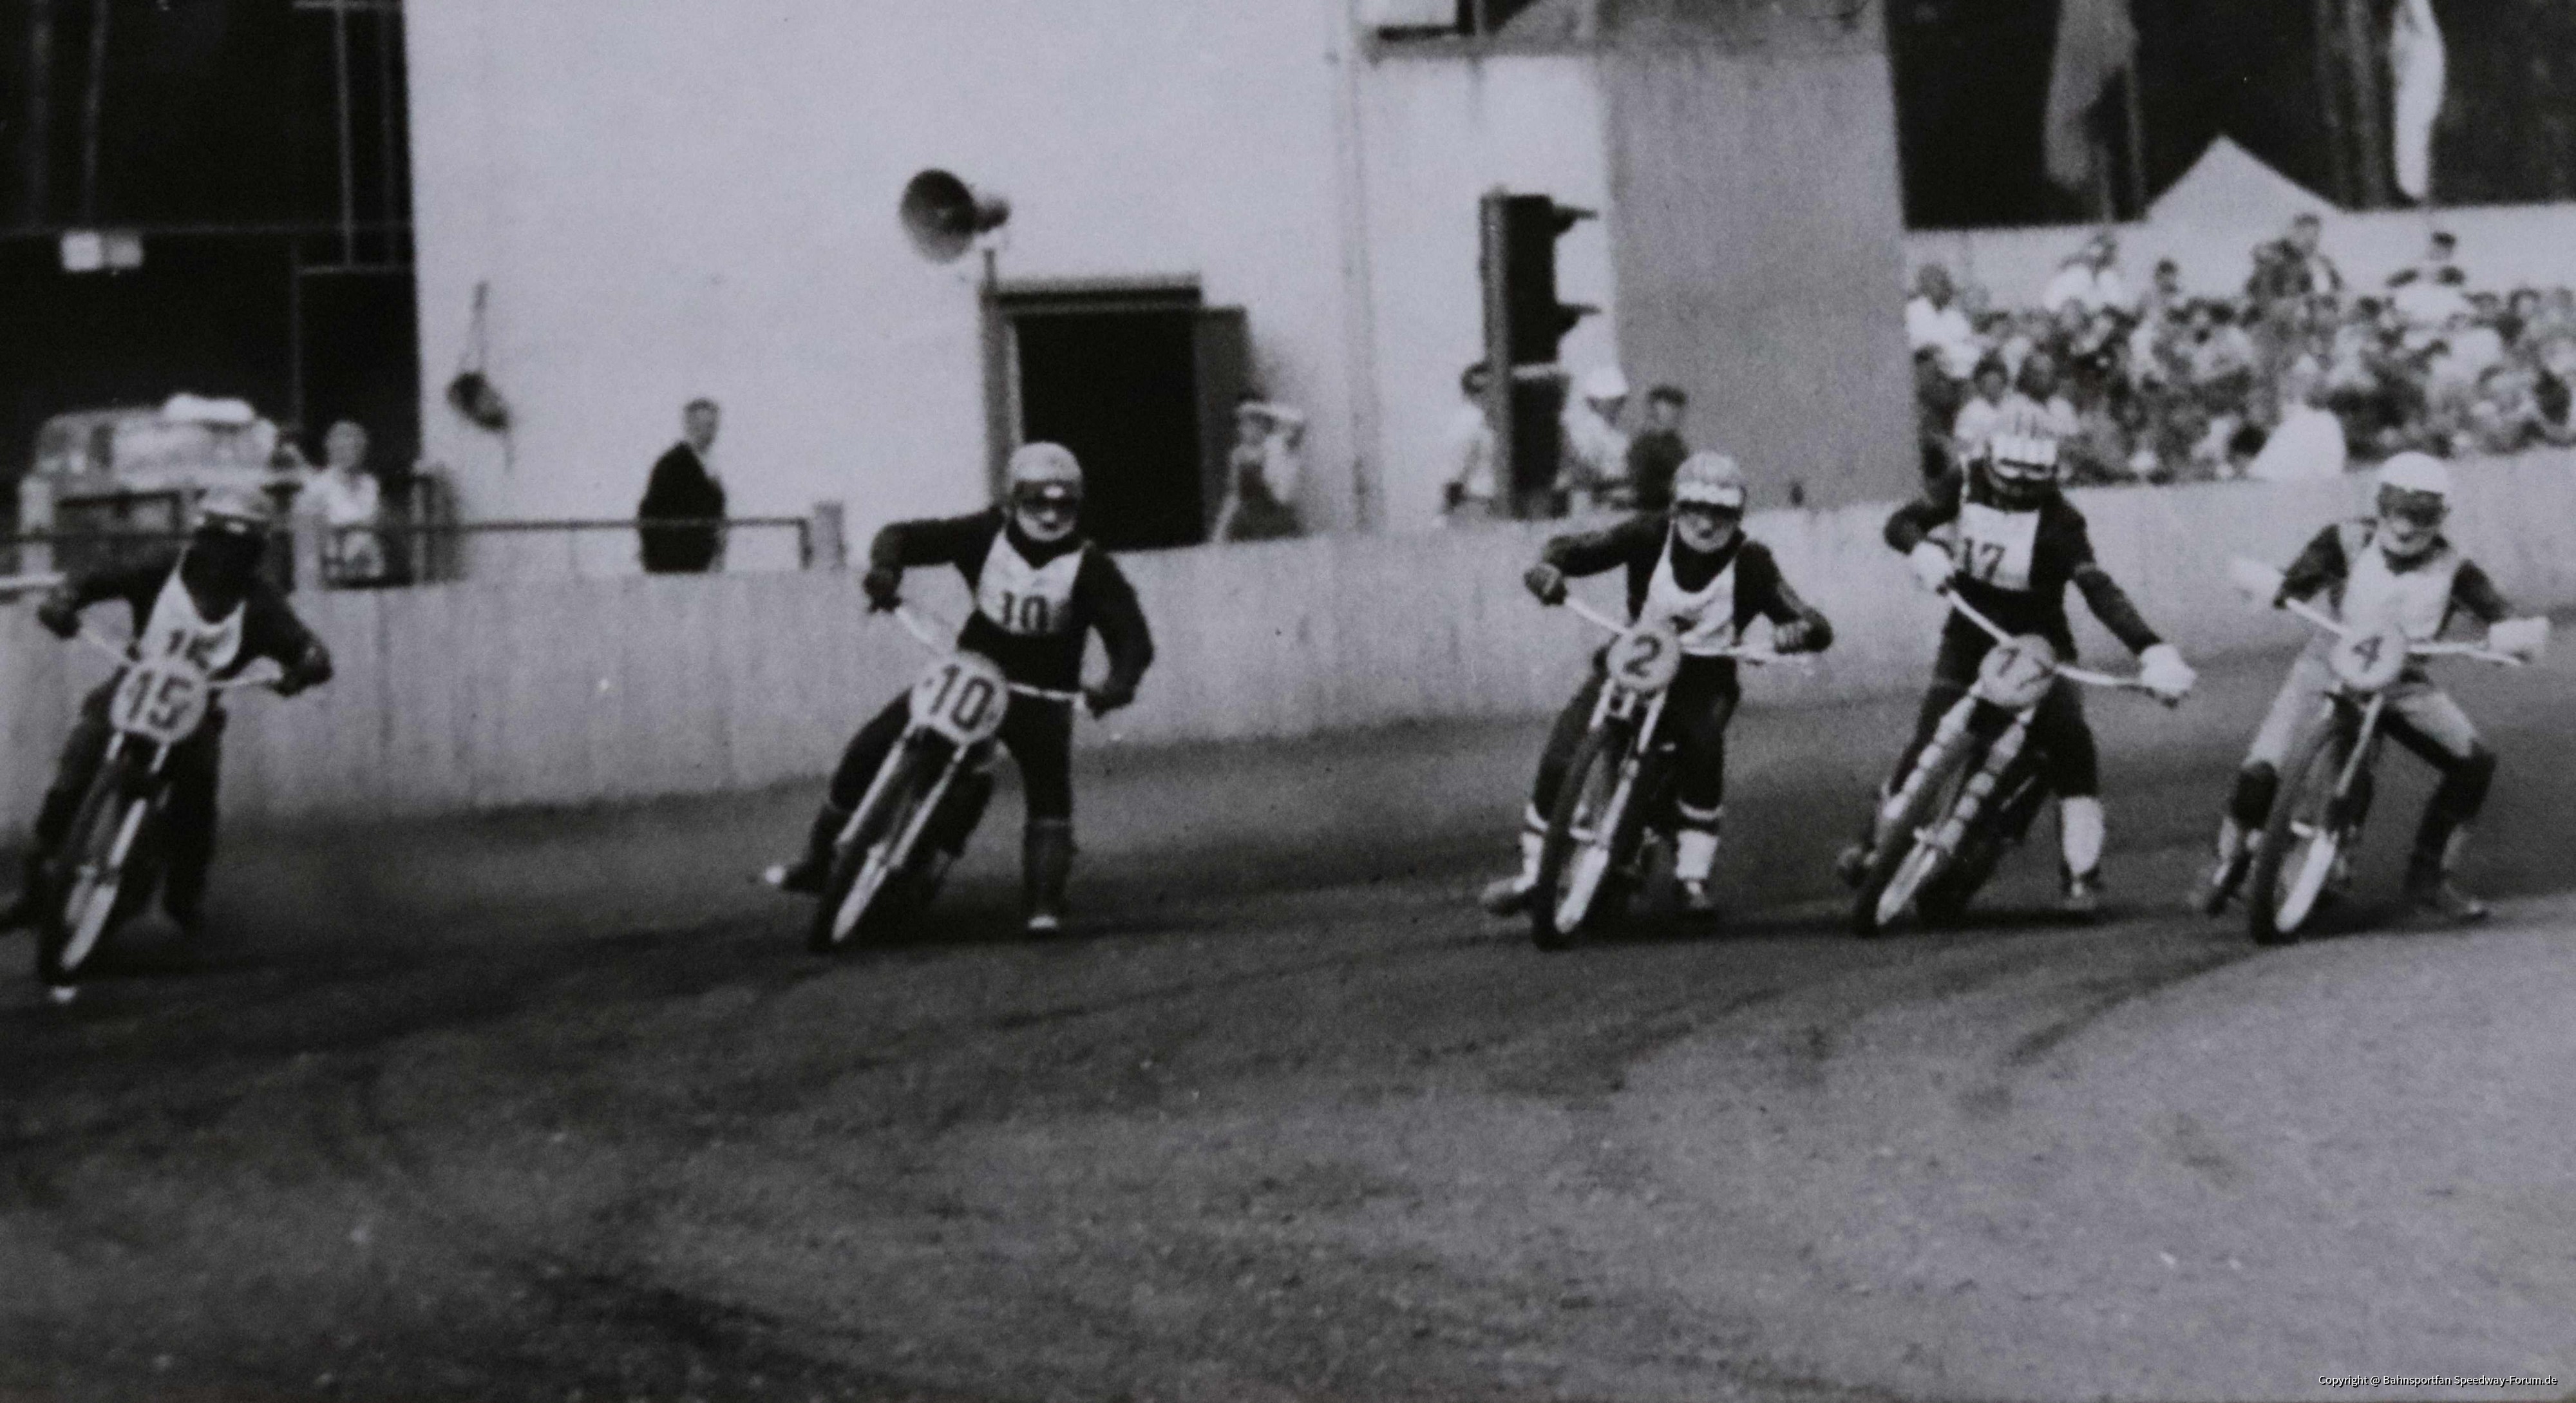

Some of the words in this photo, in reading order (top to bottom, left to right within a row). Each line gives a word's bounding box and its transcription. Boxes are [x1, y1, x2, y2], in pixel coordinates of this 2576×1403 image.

[1003, 591, 1049, 630] 10
[1622, 633, 1662, 677] 2
[2351, 635, 2384, 673] 4
[129, 670, 192, 730] 15
[929, 664, 996, 730] 10
